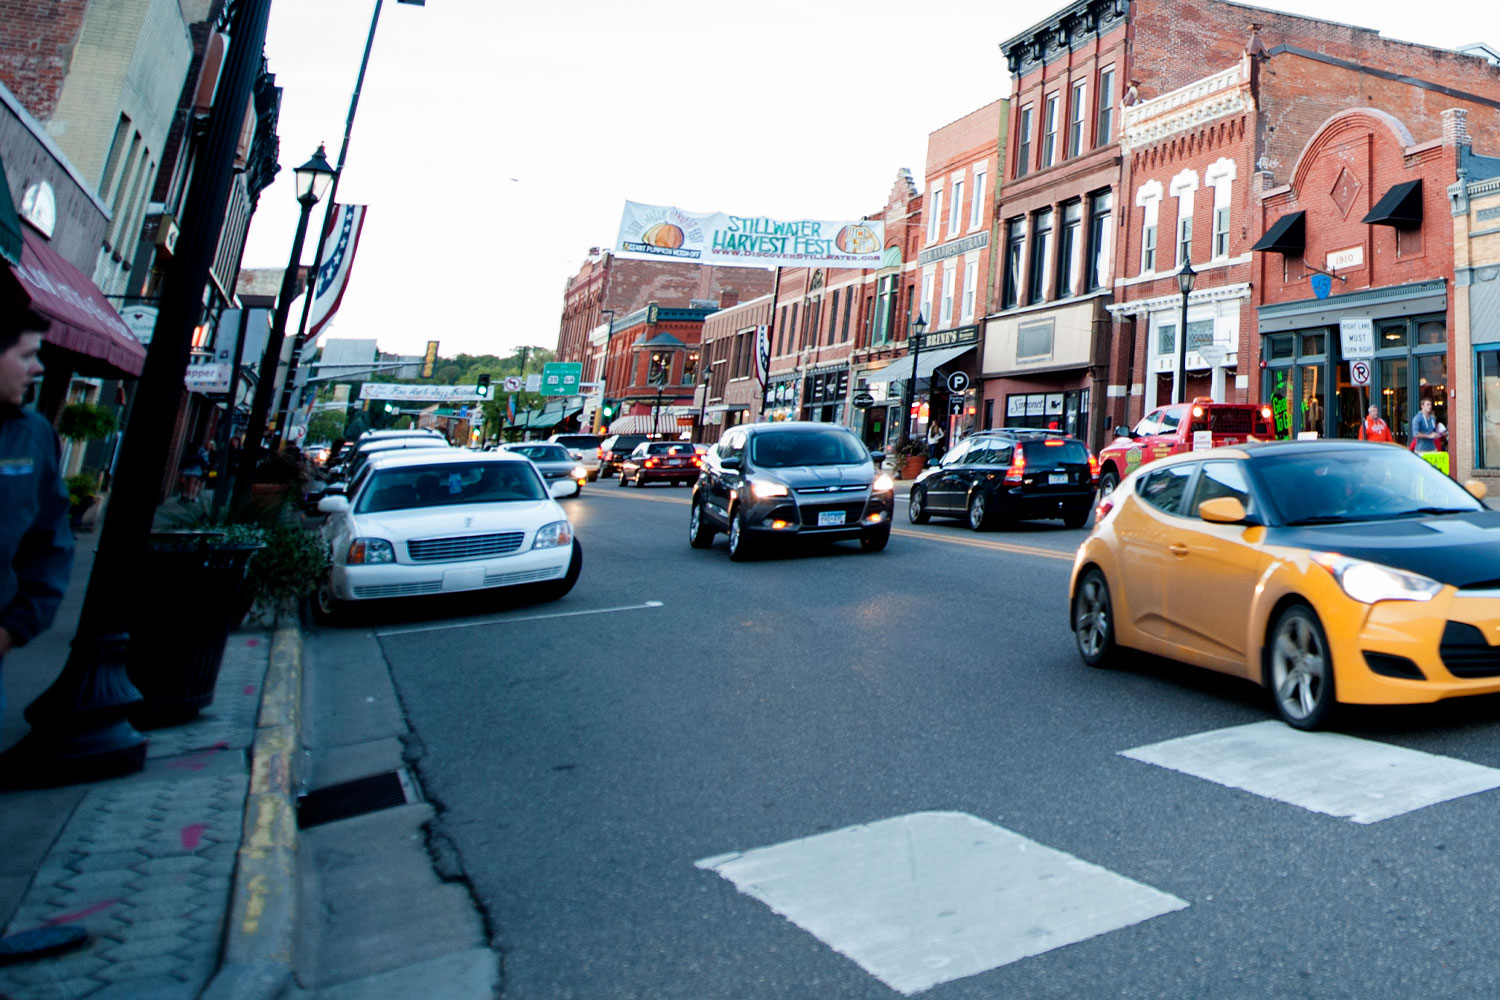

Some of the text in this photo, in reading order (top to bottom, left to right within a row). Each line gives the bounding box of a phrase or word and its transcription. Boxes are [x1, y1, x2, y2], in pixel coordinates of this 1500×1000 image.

[728, 215, 821, 238] STILLWATER
[712, 230, 789, 254] HARVEST
[794, 235, 833, 255] FEST
[1336, 254, 1354, 265] 1910
[925, 331, 957, 347] BRINE'S
[1349, 334, 1366, 342] MUST
[953, 376, 965, 389] P
[1010, 398, 1043, 415] Simonet
